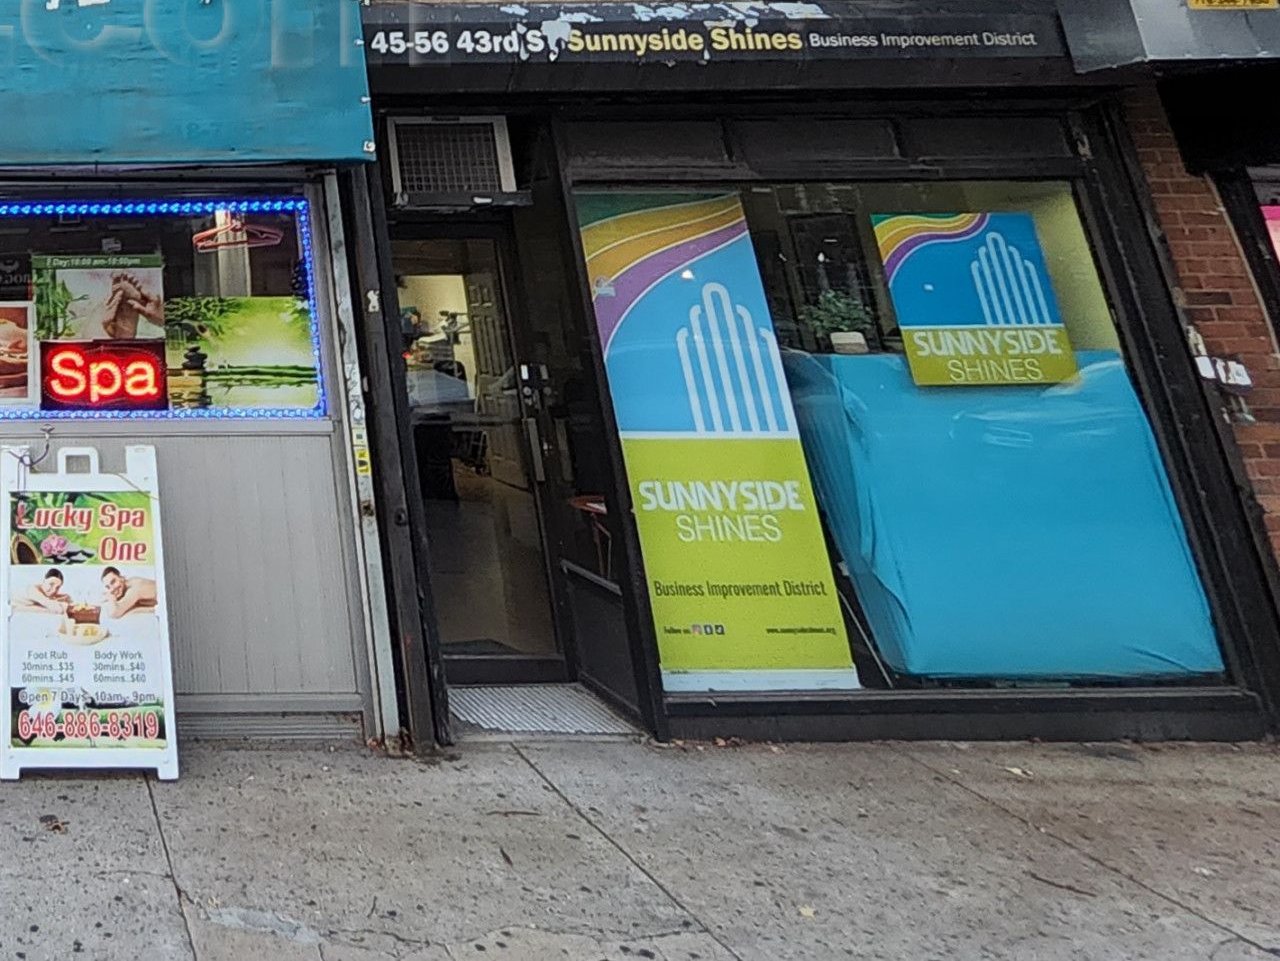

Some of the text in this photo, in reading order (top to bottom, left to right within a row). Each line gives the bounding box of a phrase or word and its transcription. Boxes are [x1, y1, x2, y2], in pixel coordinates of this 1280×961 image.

[370, 30, 450, 54] 45-56
[456, 29, 519, 54] 43rd
[568, 27, 704, 57] Sunnyside
[710, 27, 803, 51] Shines
[809, 32, 879, 48] Business
[881, 32, 979, 49] Improvement
[983, 31, 1038, 47] District
[913, 330, 1064, 357] SUNNYSIDE
[49, 349, 159, 404] Spa
[947, 358, 1045, 383] SHINES
[638, 480, 806, 511] SUNNYSIDE
[16, 502, 146, 531] Lucky Spa
[675, 514, 783, 543] SHINES
[100, 538, 148, 562] One
[653, 580, 828, 599] Business Improvement District
[27, 650, 68, 660] Foot Rub
[94, 650, 143, 662] Body Work
[20, 691, 48, 703] Open
[51, 691, 58, 702] 7
[95, 691, 123, 702] 10am
[19, 710, 160, 740] 646-886-8319
